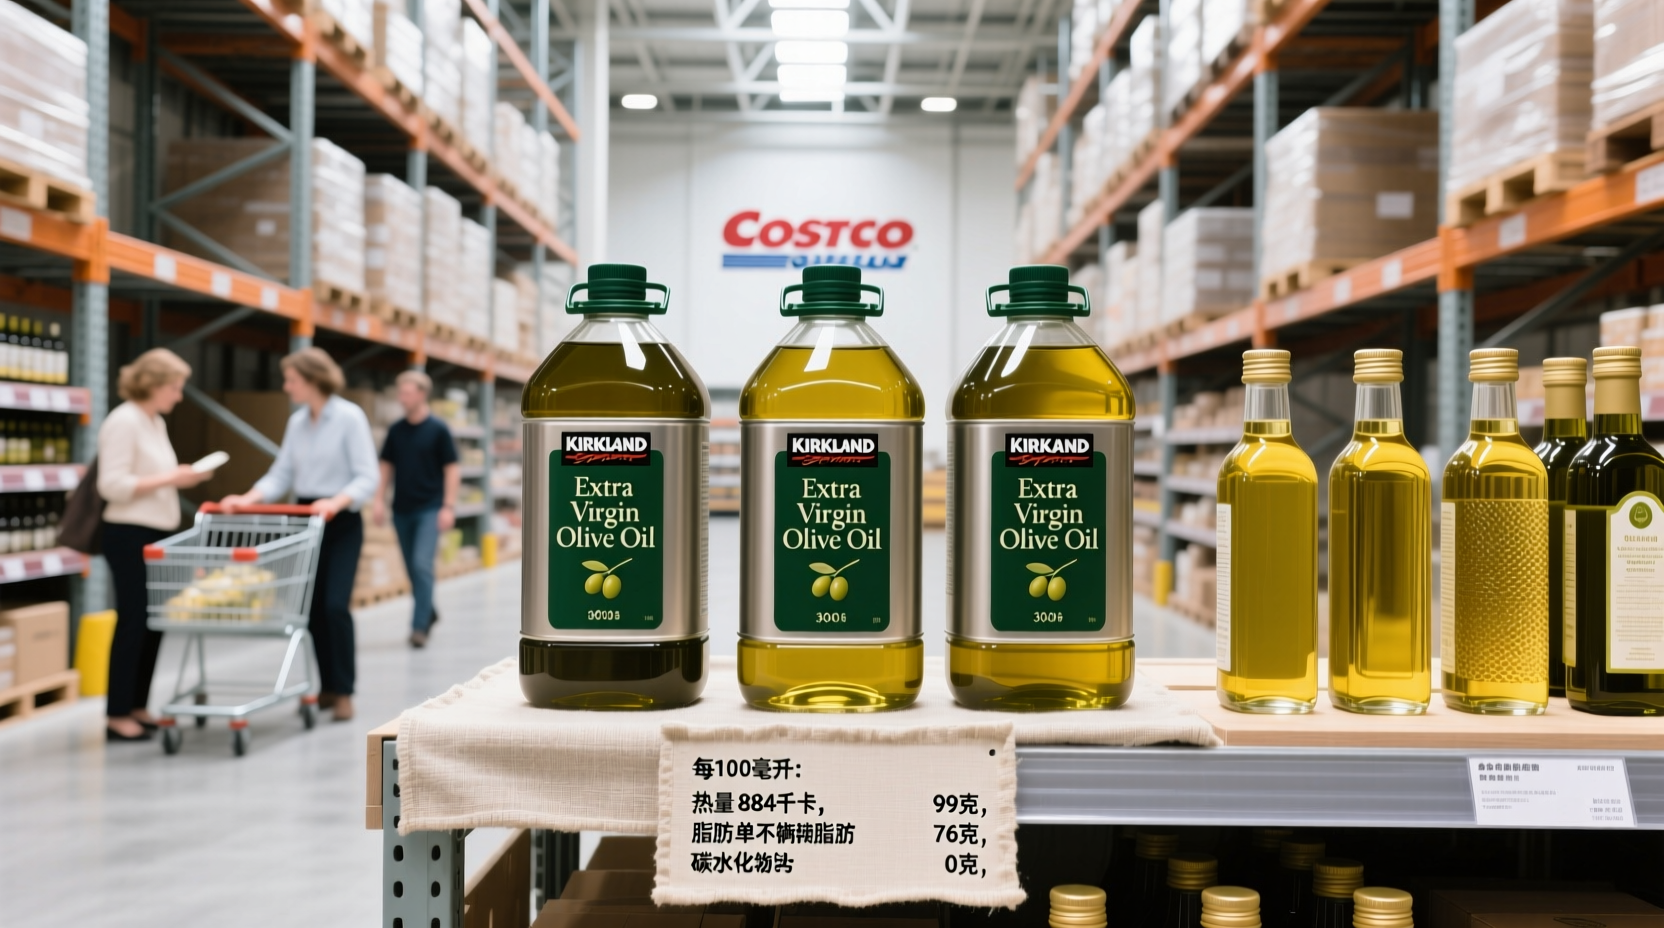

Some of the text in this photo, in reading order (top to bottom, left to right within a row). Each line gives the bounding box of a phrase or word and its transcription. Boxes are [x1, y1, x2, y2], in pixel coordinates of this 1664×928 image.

[723, 211, 913, 249] COSTCO
[566, 437, 647, 451] KIRKLAND
[793, 438, 874, 453] KIRKLAND
[1011, 438, 1089, 453] KIRKAND
[575, 477, 633, 496] Extra
[803, 479, 861, 498] Extra
[1019, 478, 1077, 498] Extra
[568, 501, 639, 529] Virgin
[795, 503, 866, 531] Virgin
[1012, 503, 1083, 531] Virgin
[557, 525, 655, 548] Olive Oil
[783, 527, 881, 549] Olive Oil
[1000, 527, 1098, 549] Olive Oil
